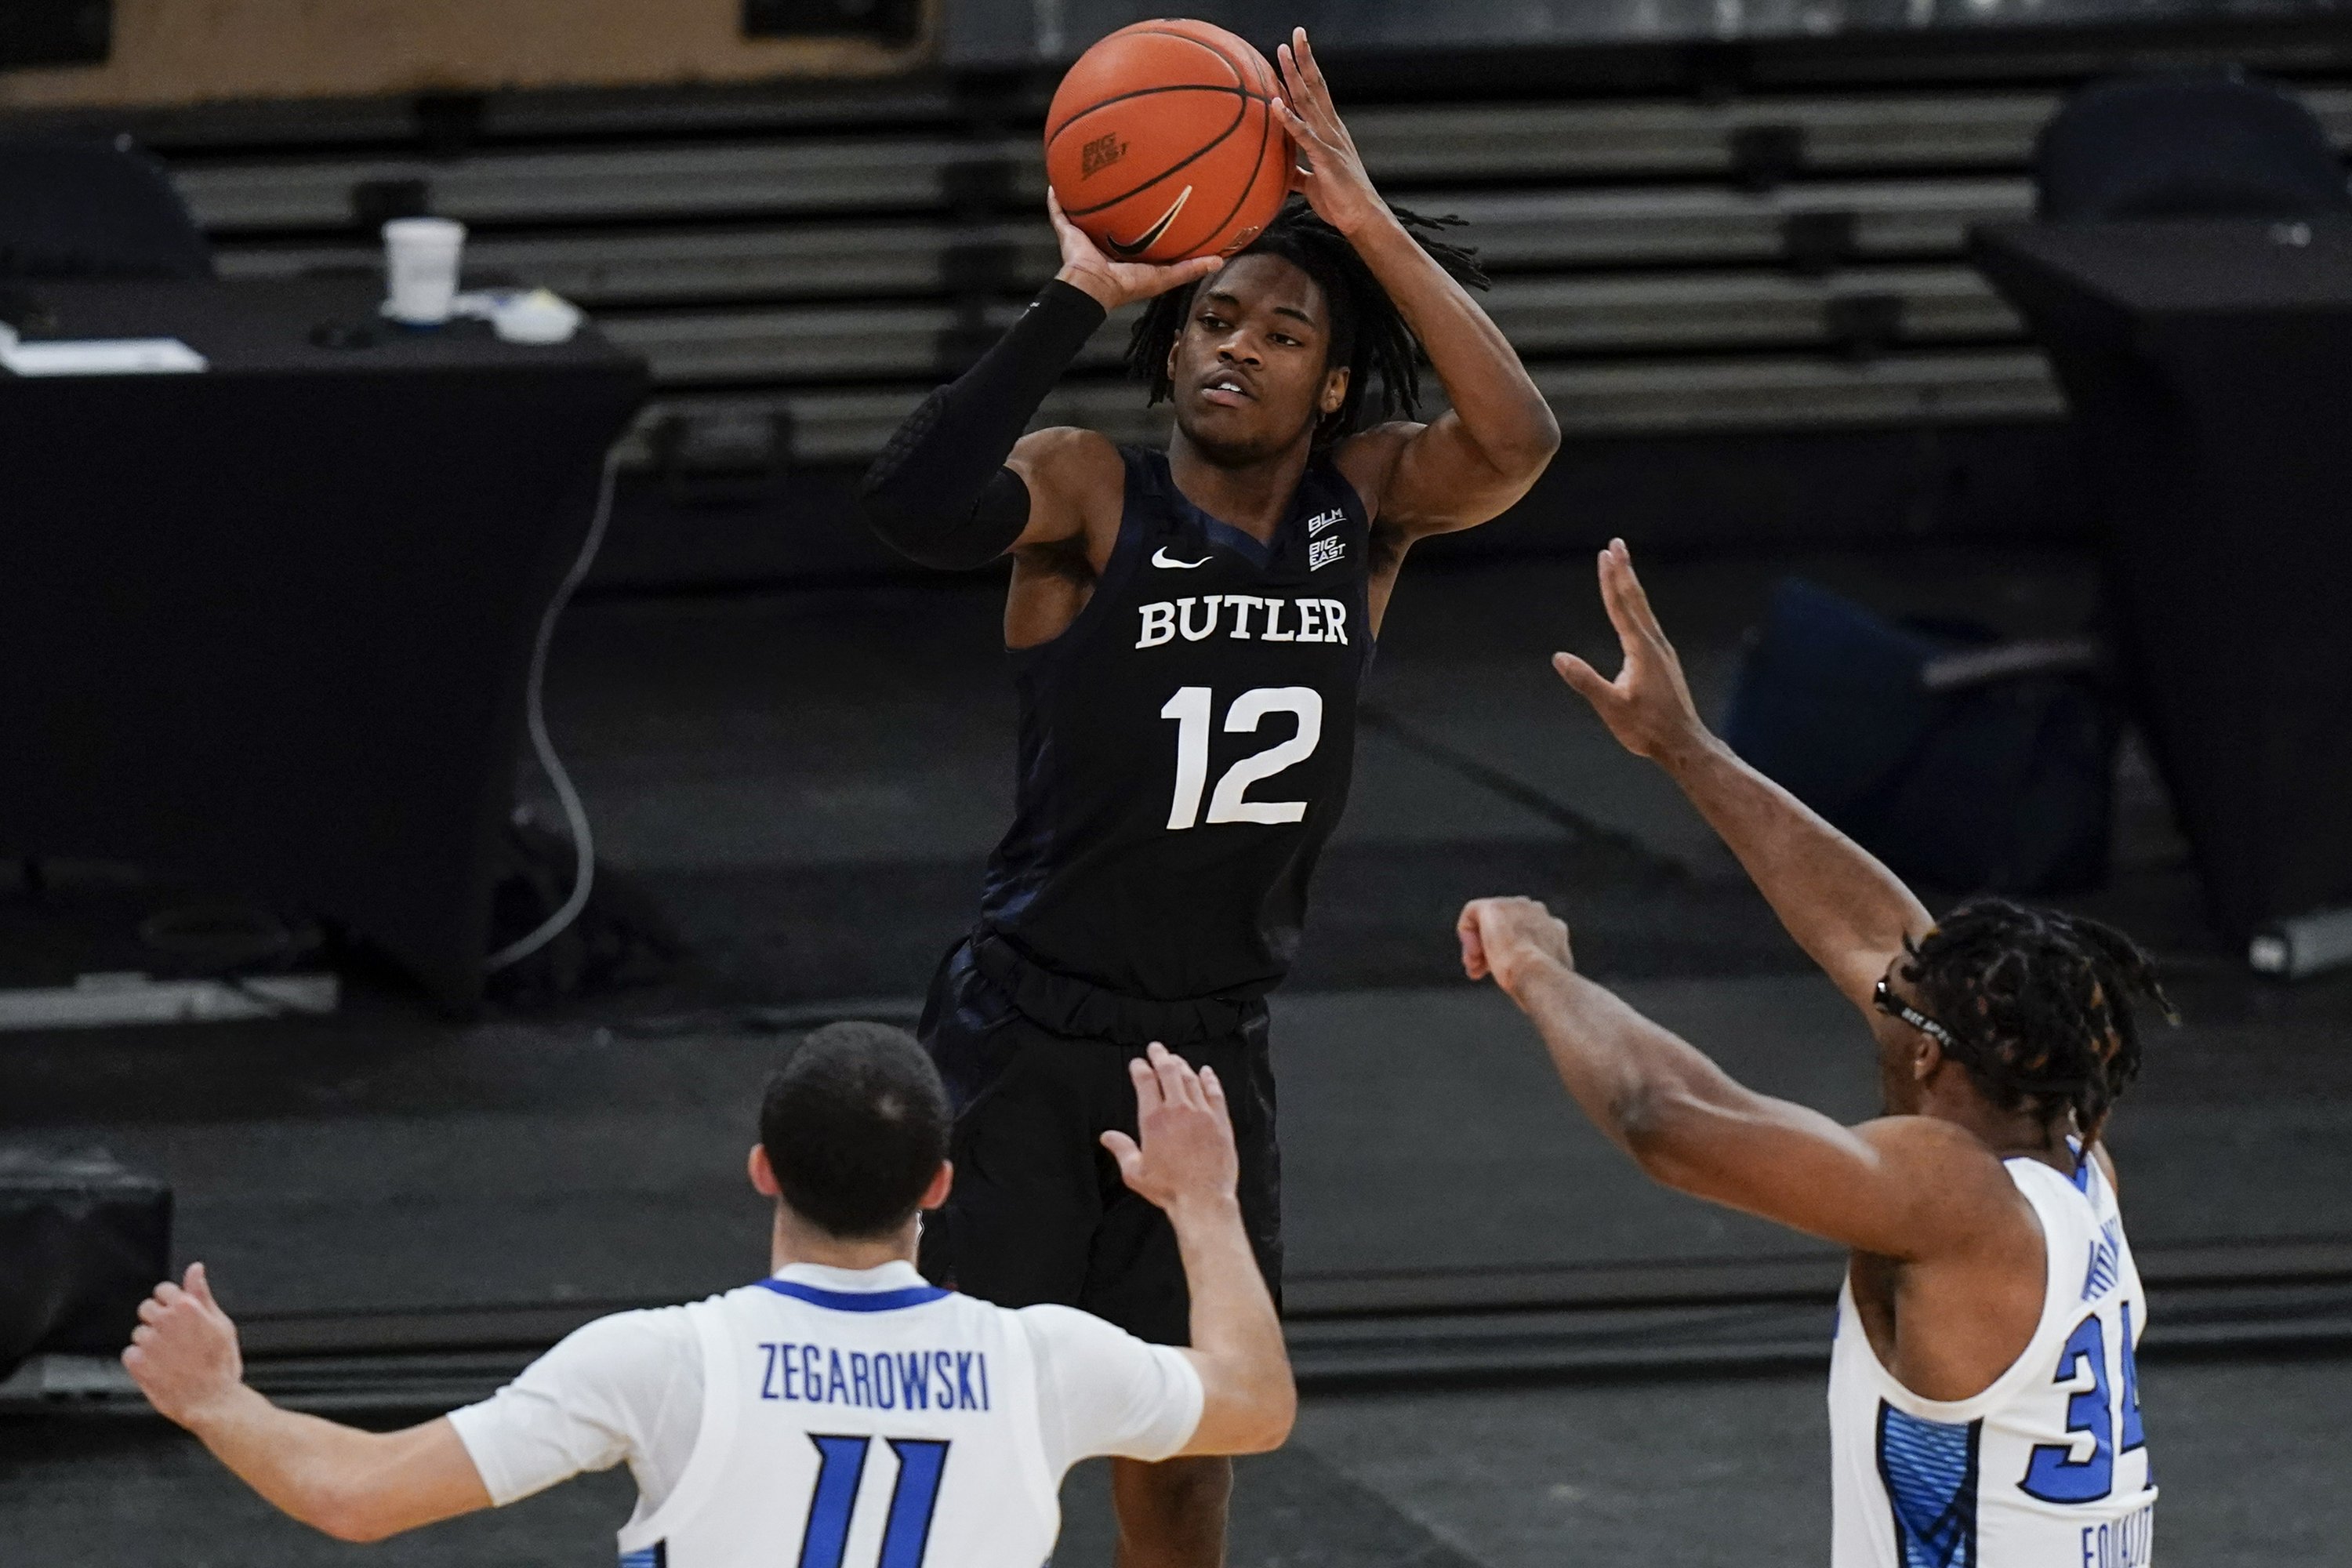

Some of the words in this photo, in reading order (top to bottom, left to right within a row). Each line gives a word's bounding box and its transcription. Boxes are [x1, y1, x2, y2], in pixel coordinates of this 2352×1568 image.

[1082, 142, 1131, 172] EAST
[1083, 132, 1116, 156] BIG
[1308, 507, 1344, 532] BLM
[1308, 535, 1340, 556] BIG
[1308, 543, 1346, 567] EAST
[1134, 594, 1349, 650] BUTLER
[1160, 686, 1323, 830] 12
[757, 1341, 991, 1412] ZEGAROWSKI
[797, 1430, 952, 1568] 11
